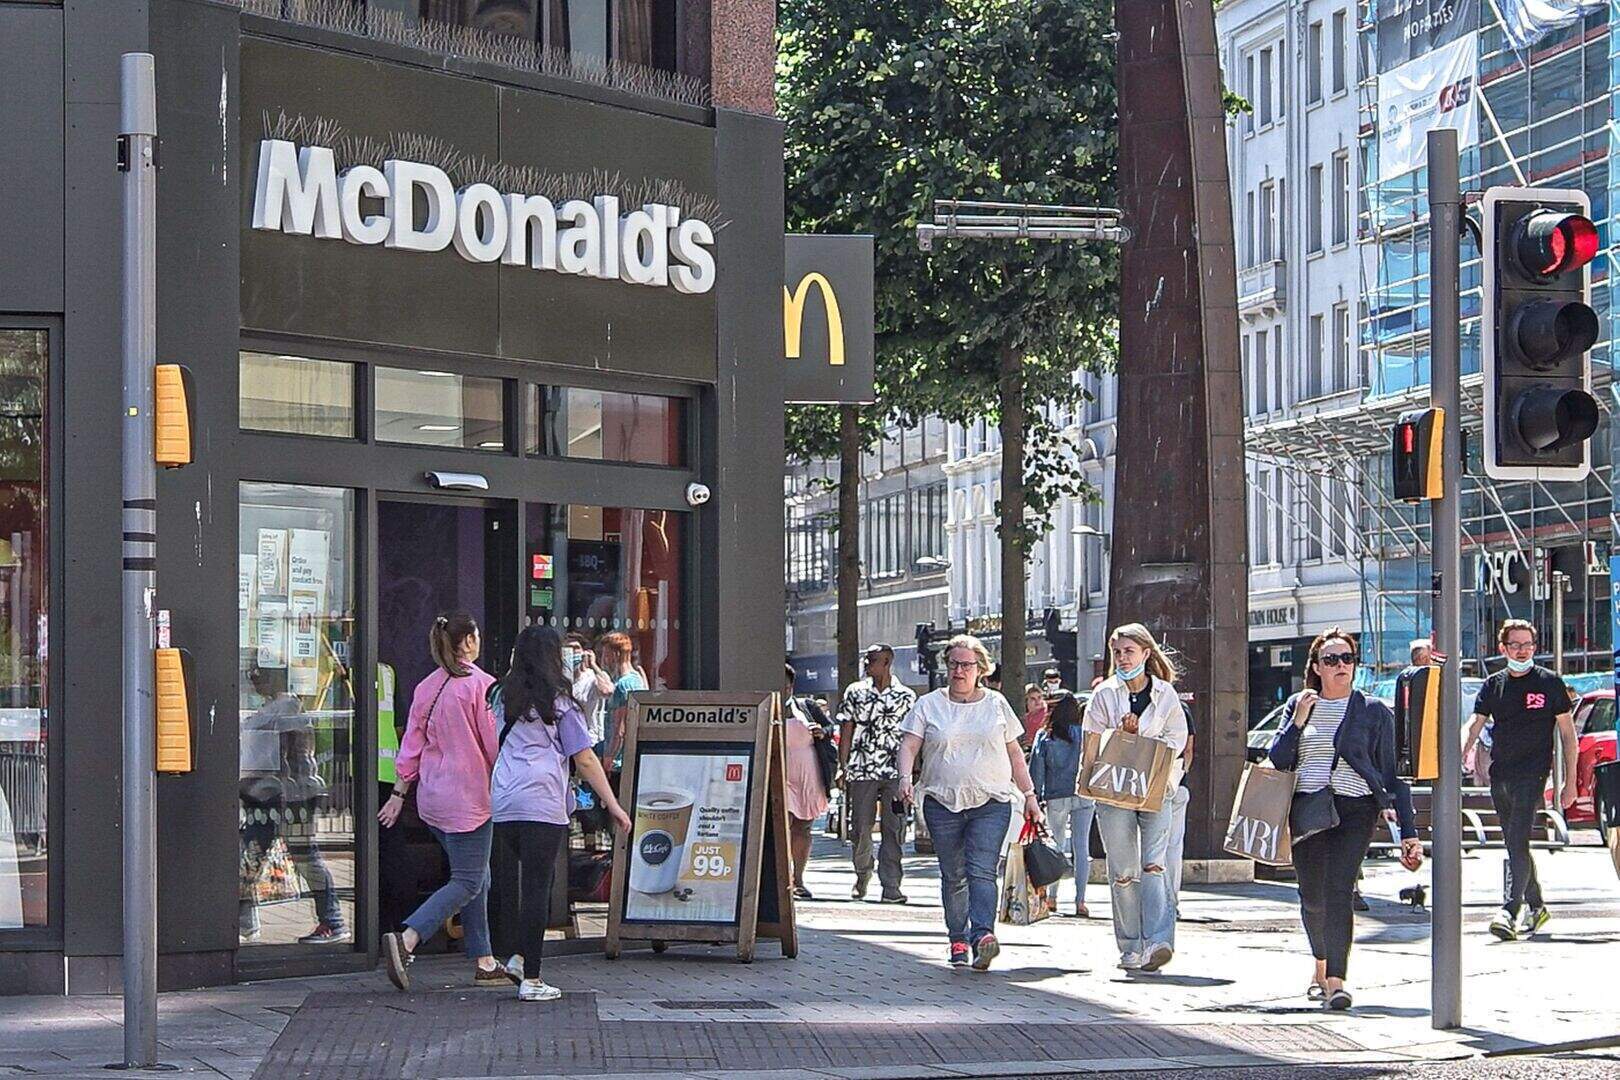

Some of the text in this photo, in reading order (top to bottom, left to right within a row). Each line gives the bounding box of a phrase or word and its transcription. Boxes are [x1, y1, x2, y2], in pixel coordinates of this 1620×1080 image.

[251, 139, 716, 294] McDonald's
[1526, 693, 1545, 705] PS
[646, 707, 750, 723] McDonald's
[1088, 760, 1148, 798] ZARA
[699, 806, 740, 814] Quality coffee
[694, 846, 721, 855] JUST
